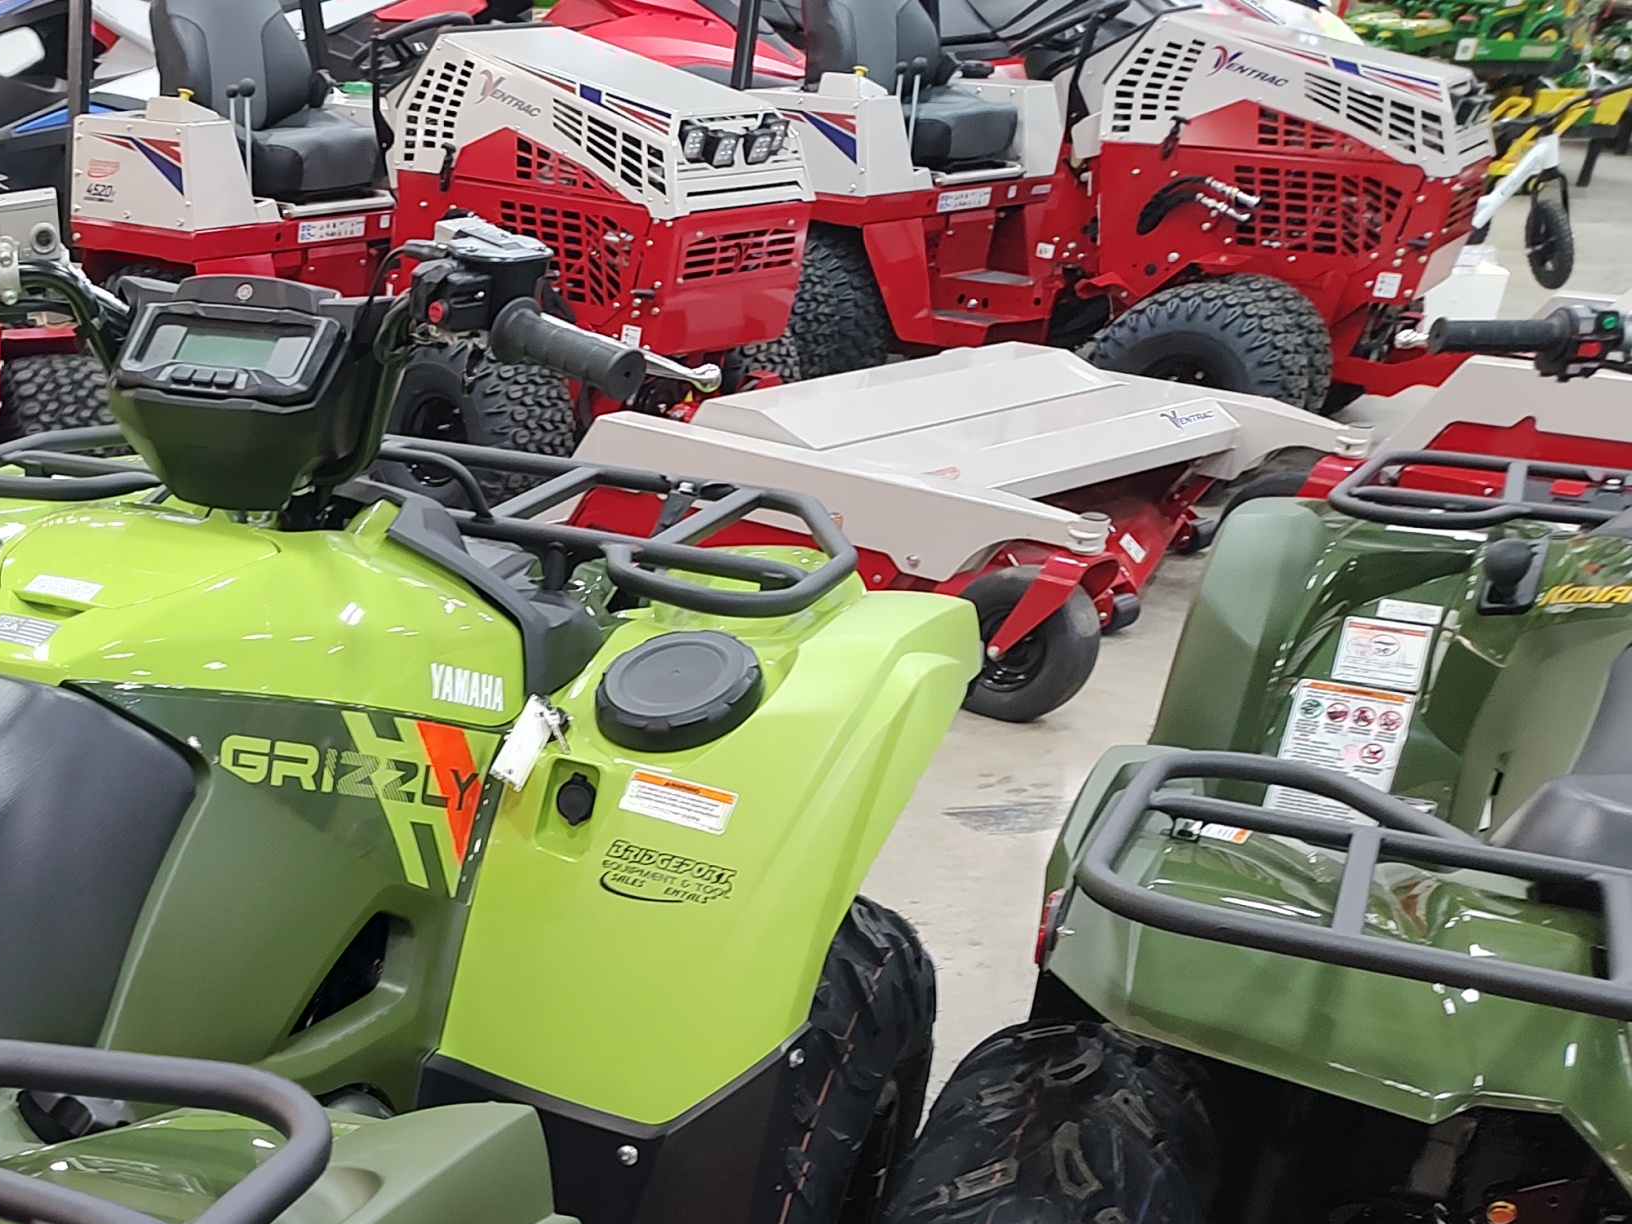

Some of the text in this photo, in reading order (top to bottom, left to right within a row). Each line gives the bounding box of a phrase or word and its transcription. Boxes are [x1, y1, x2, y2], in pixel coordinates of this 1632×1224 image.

[1206, 44, 1289, 87] VENTRAC
[474, 69, 542, 117] VENTRAC
[1159, 409, 1216, 432] VENTRAC
[1536, 582, 1632, 608] KODIA
[430, 662, 504, 712] YAMAHA
[220, 734, 480, 811] GRIZZLY
[602, 859, 678, 885] EQUIPMENT
[605, 838, 737, 884] BRIDGEPORT
[610, 872, 646, 888] SALES
